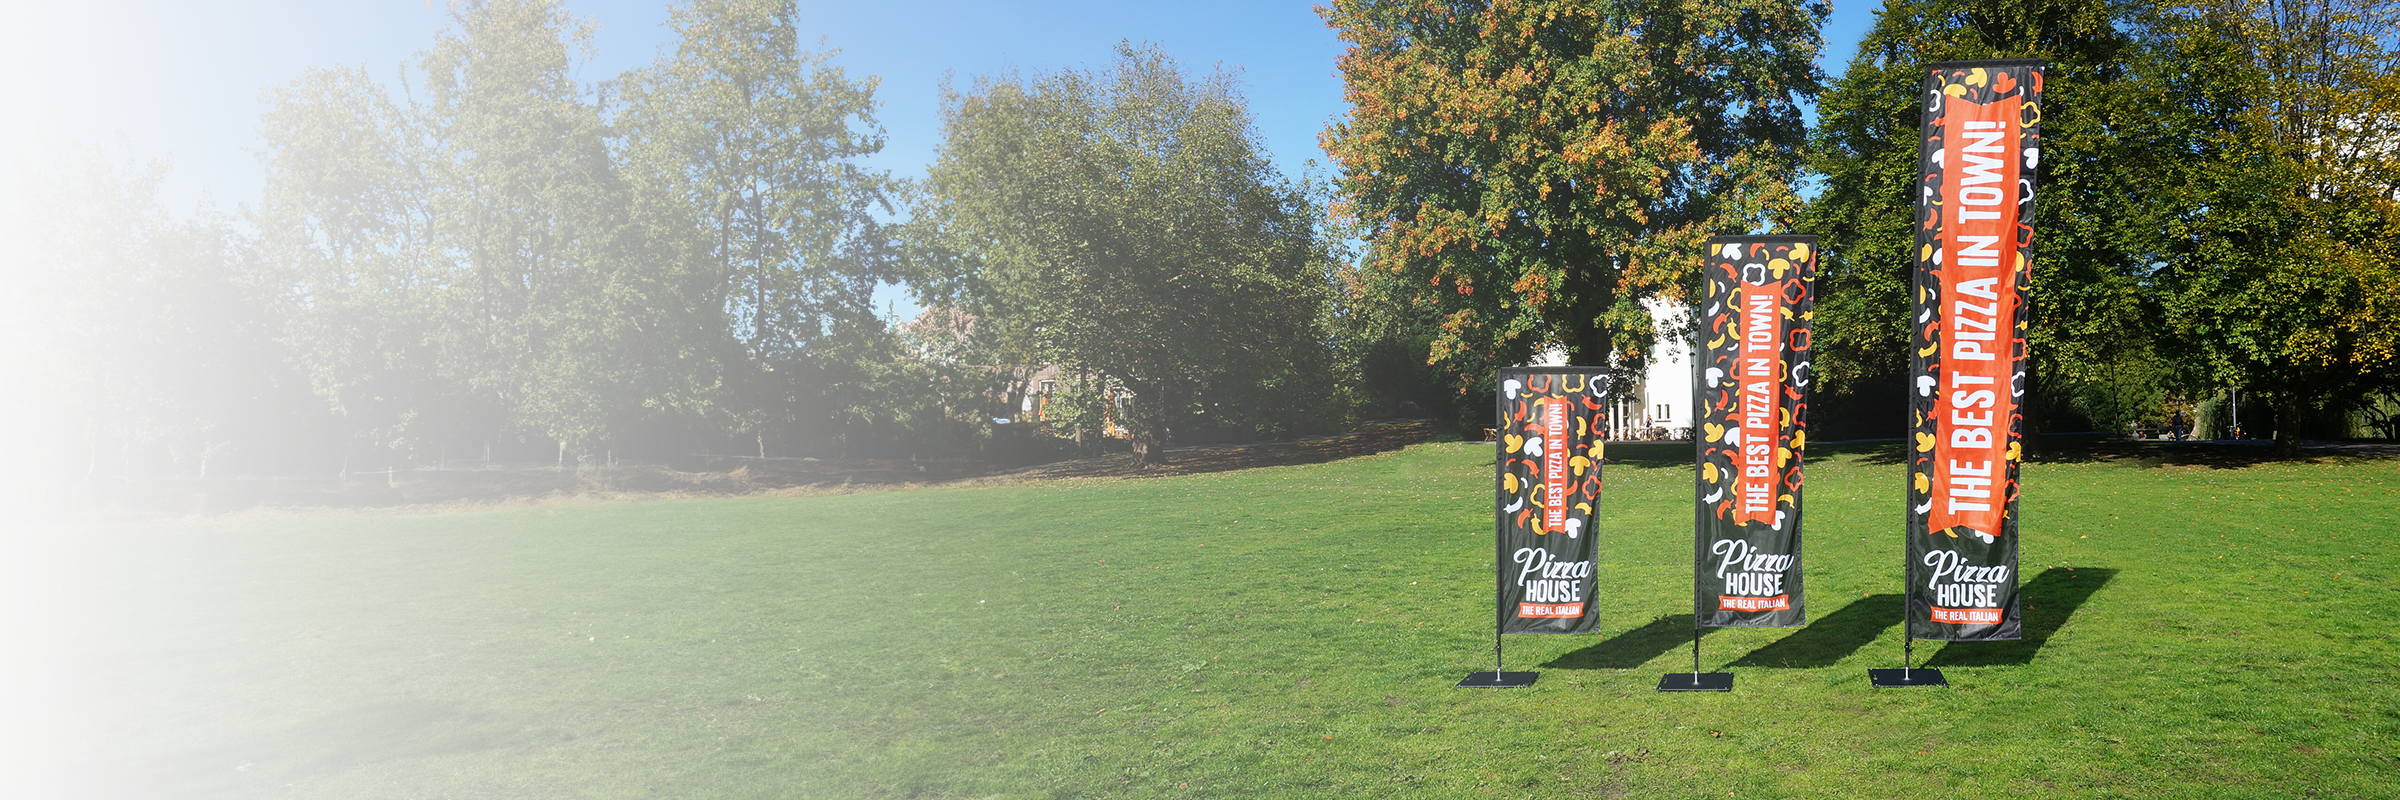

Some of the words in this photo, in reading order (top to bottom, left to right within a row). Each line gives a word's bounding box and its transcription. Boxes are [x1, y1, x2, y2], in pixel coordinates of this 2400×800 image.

[1958, 120, 2006, 225] TOWN!
[1957, 234, 2000, 268] IN
[1747, 294, 1774, 354] TOWN!
[1953, 276, 1999, 361] PIZZA
[1747, 357, 1771, 378] IN
[1548, 403, 1564, 437] TOWN!
[1746, 381, 1771, 429] PIZZA
[1951, 371, 1995, 450] BEST
[1548, 438, 1563, 450] IN
[1745, 433, 1770, 478] BEST
[1548, 451, 1563, 479] PIZZA
[1548, 480, 1563, 506] BEST
[1745, 481, 1769, 514] THE
[1948, 453, 1990, 516] THE
[1548, 508, 1562, 528] THE
[1513, 547, 1591, 586] Pizza
[1712, 538, 1794, 579] Pizza
[1923, 549, 2010, 590] Pizza
[1525, 579, 1580, 602] HOUSE
[1725, 572, 1784, 597] HOUSE
[1937, 583, 1998, 608] HOUSE
[1522, 605, 1534, 615] THE
[1535, 605, 1554, 616] REAL
[1555, 605, 1580, 616] ITALIAN
[1722, 599, 1736, 608] THE
[1737, 600, 1756, 609] REAL
[1757, 598, 1786, 609] ITALIAN
[1934, 609, 1948, 620] THE
[1949, 611, 1968, 621] REAL
[1969, 611, 1999, 622] ITALIAN
